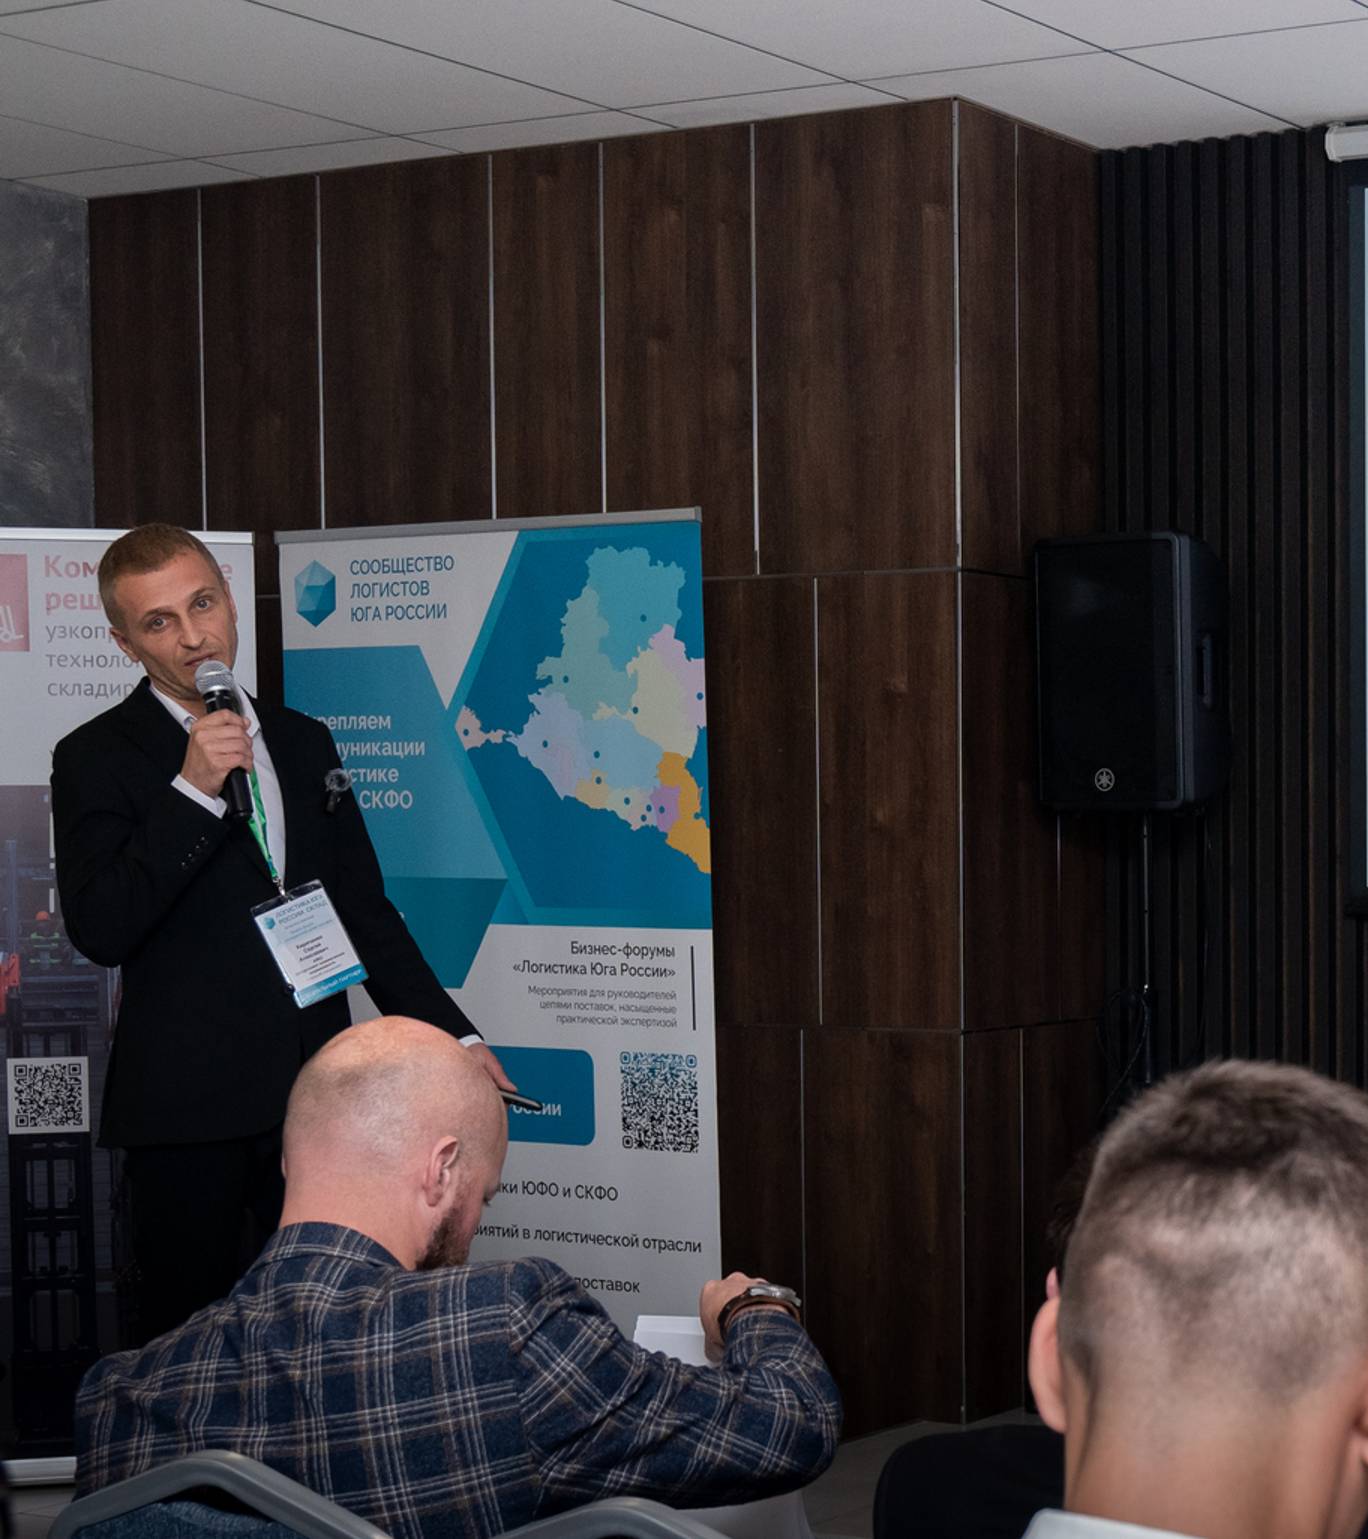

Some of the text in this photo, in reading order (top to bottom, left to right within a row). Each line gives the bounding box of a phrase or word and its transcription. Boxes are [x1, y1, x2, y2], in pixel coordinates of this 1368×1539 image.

[44, 555, 101, 578] Ком
[350, 555, 455, 575] СООБЩЕСТВО
[350, 580, 431, 599] ЛОГИСТОВ
[46, 592, 102, 615] реш
[351, 603, 448, 622] ЮГА РОССИИ
[46, 625, 112, 643] узкоп
[46, 653, 140, 668] техноло
[47, 682, 135, 698] складир
[317, 714, 392, 730] епляем
[336, 741, 426, 761] уникации
[345, 767, 400, 783] стике
[359, 788, 414, 809] СКФО
[570, 940, 676, 960] Бизнес-форумы
[512, 959, 677, 978] «Логистика Юга России»
[528, 985, 677, 1001] Мероприятия для руководителей
[556, 1014, 678, 1028] практической экспертизой
[521, 1181, 559, 1197] ЮФО
[562, 1187, 571, 1198] и
[575, 1184, 619, 1201] СКФО
[475, 1224, 703, 1254] иятий в логистической отрасли
